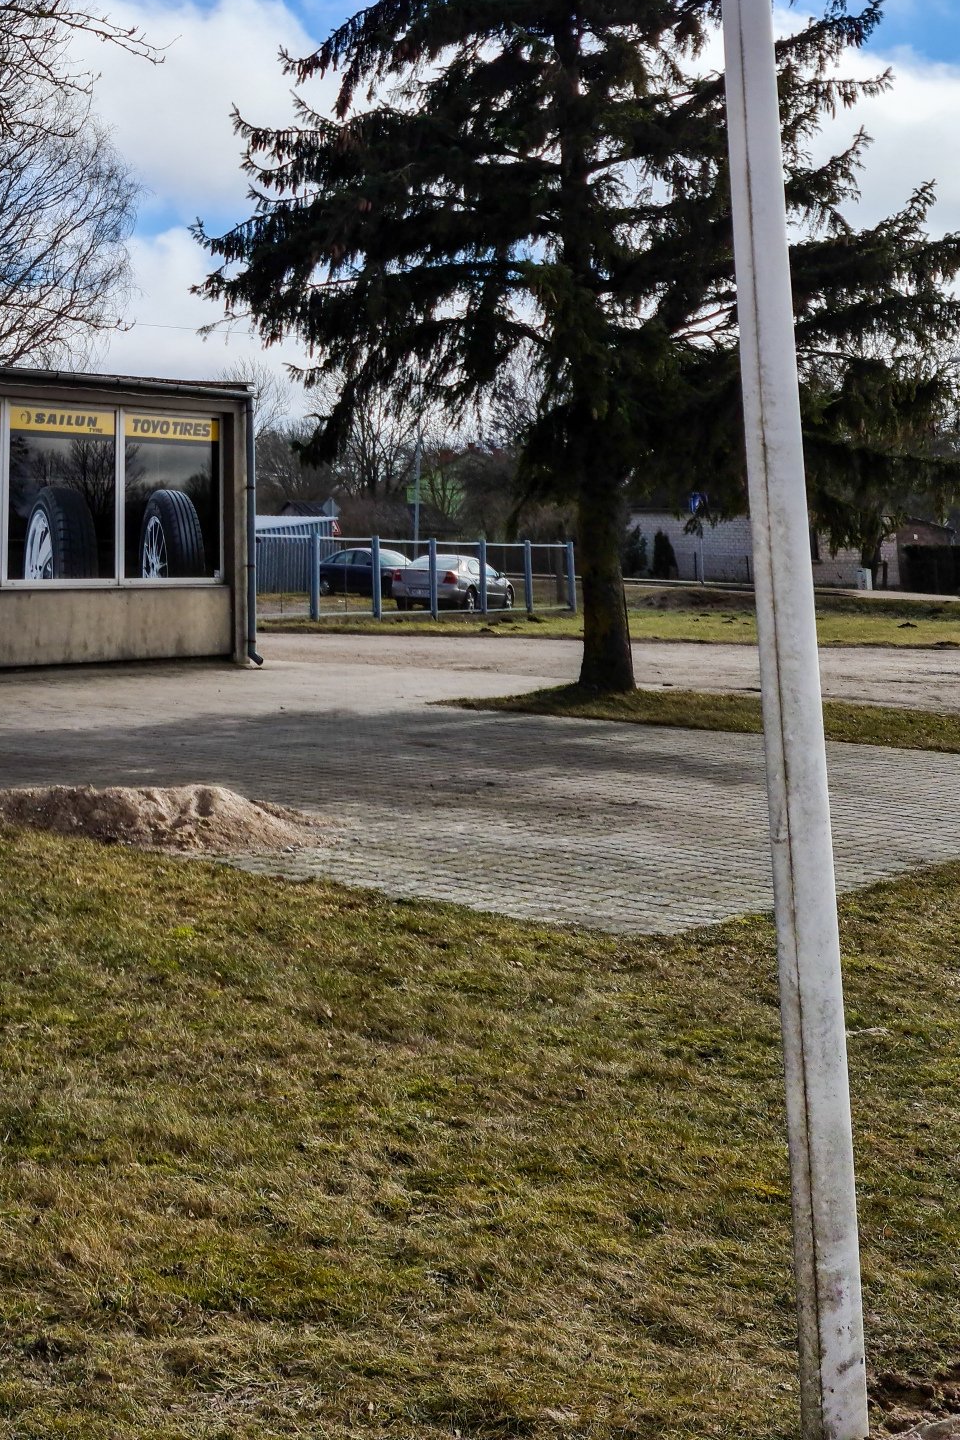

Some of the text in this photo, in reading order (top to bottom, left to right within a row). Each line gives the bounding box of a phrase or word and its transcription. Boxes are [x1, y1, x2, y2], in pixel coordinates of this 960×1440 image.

[35, 412, 97, 427] SAILUN
[132, 418, 211, 438] TOYO TIRES
